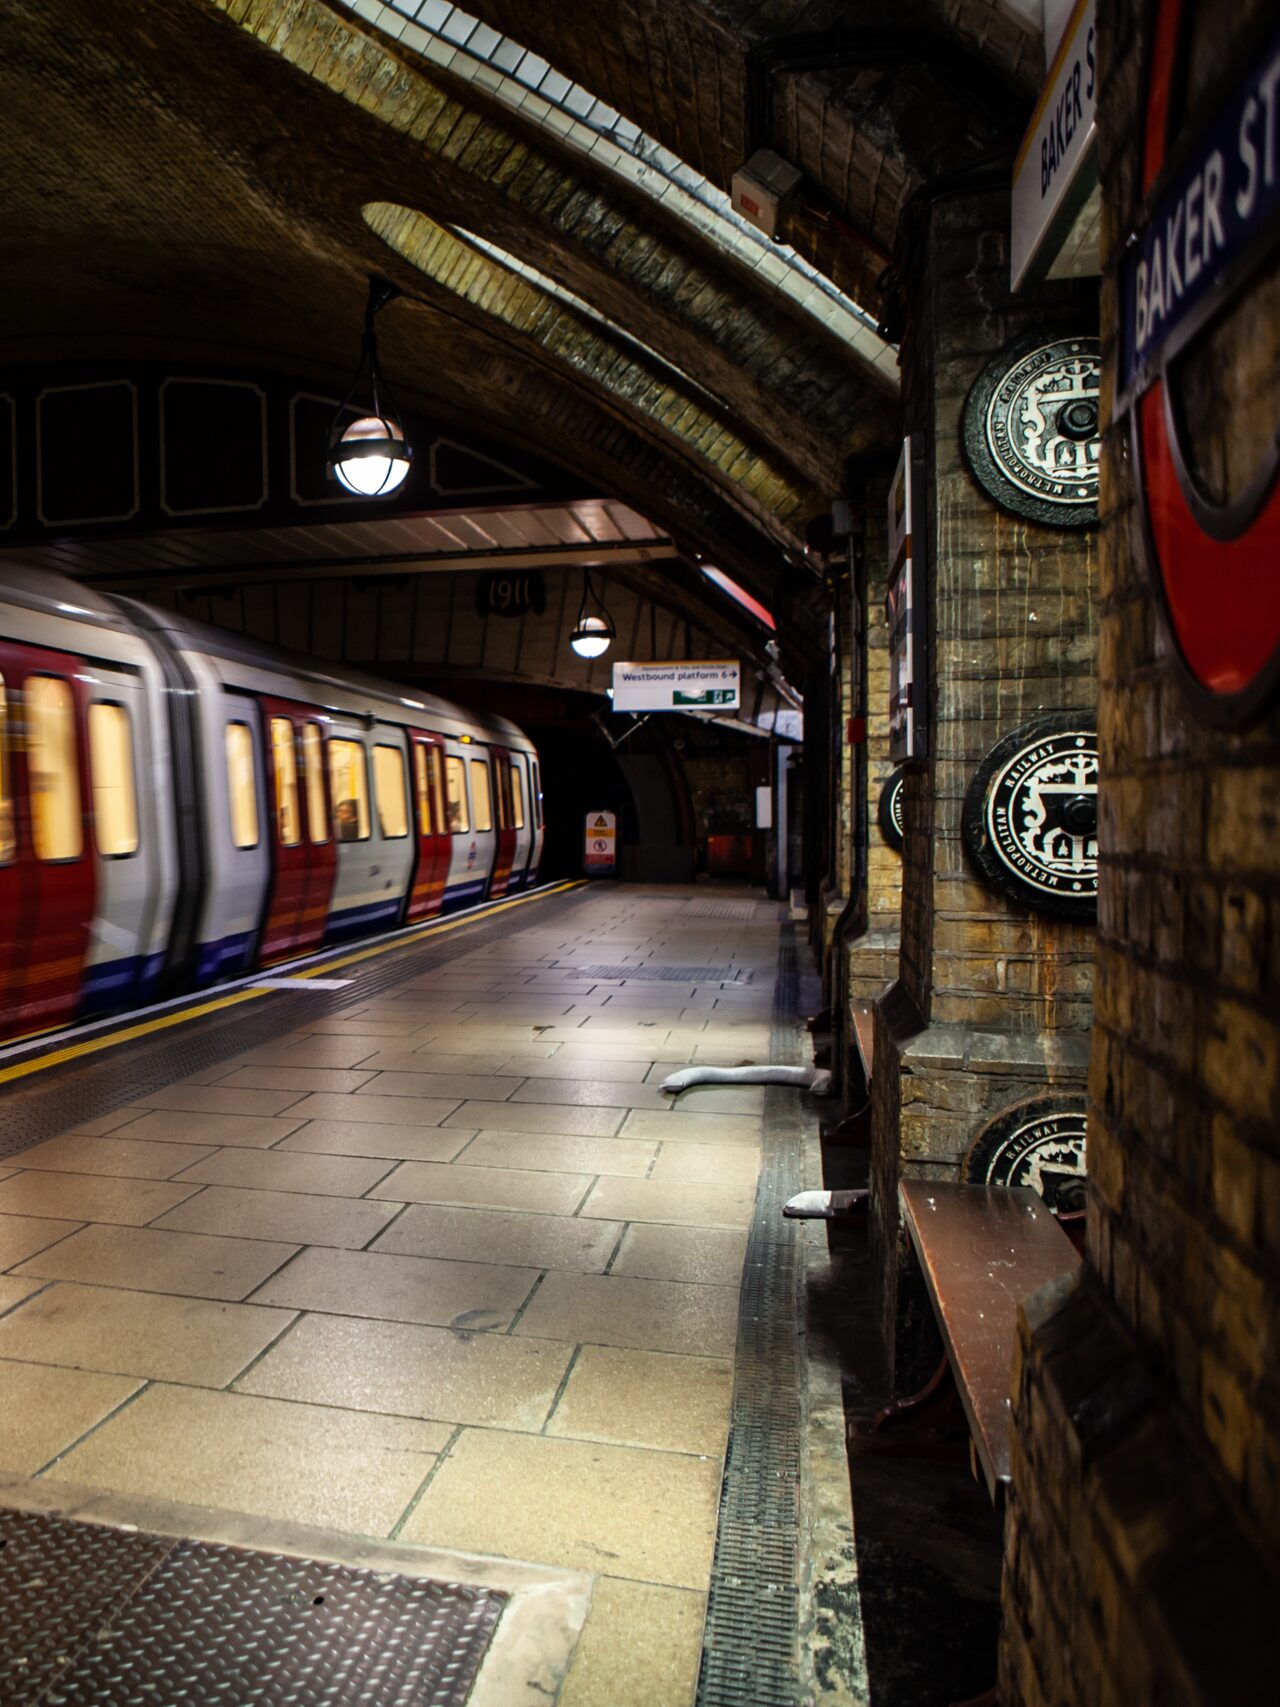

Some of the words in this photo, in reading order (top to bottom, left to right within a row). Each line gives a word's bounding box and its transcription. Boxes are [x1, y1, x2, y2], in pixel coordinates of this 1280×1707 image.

[1040, 59, 1082, 200] BAKER
[1134, 150, 1225, 351] BAKER
[994, 421, 1063, 495] METROPOLITAN
[489, 578, 530, 609] 1911
[622, 672, 675, 682] Westbound
[677, 670, 718, 682] platform
[721, 670, 728, 679] 6
[1005, 743, 1055, 789] RAILWAY
[996, 807, 1059, 886] METROPOLITAN
[1006, 1123, 1058, 1160] RAILWAY
